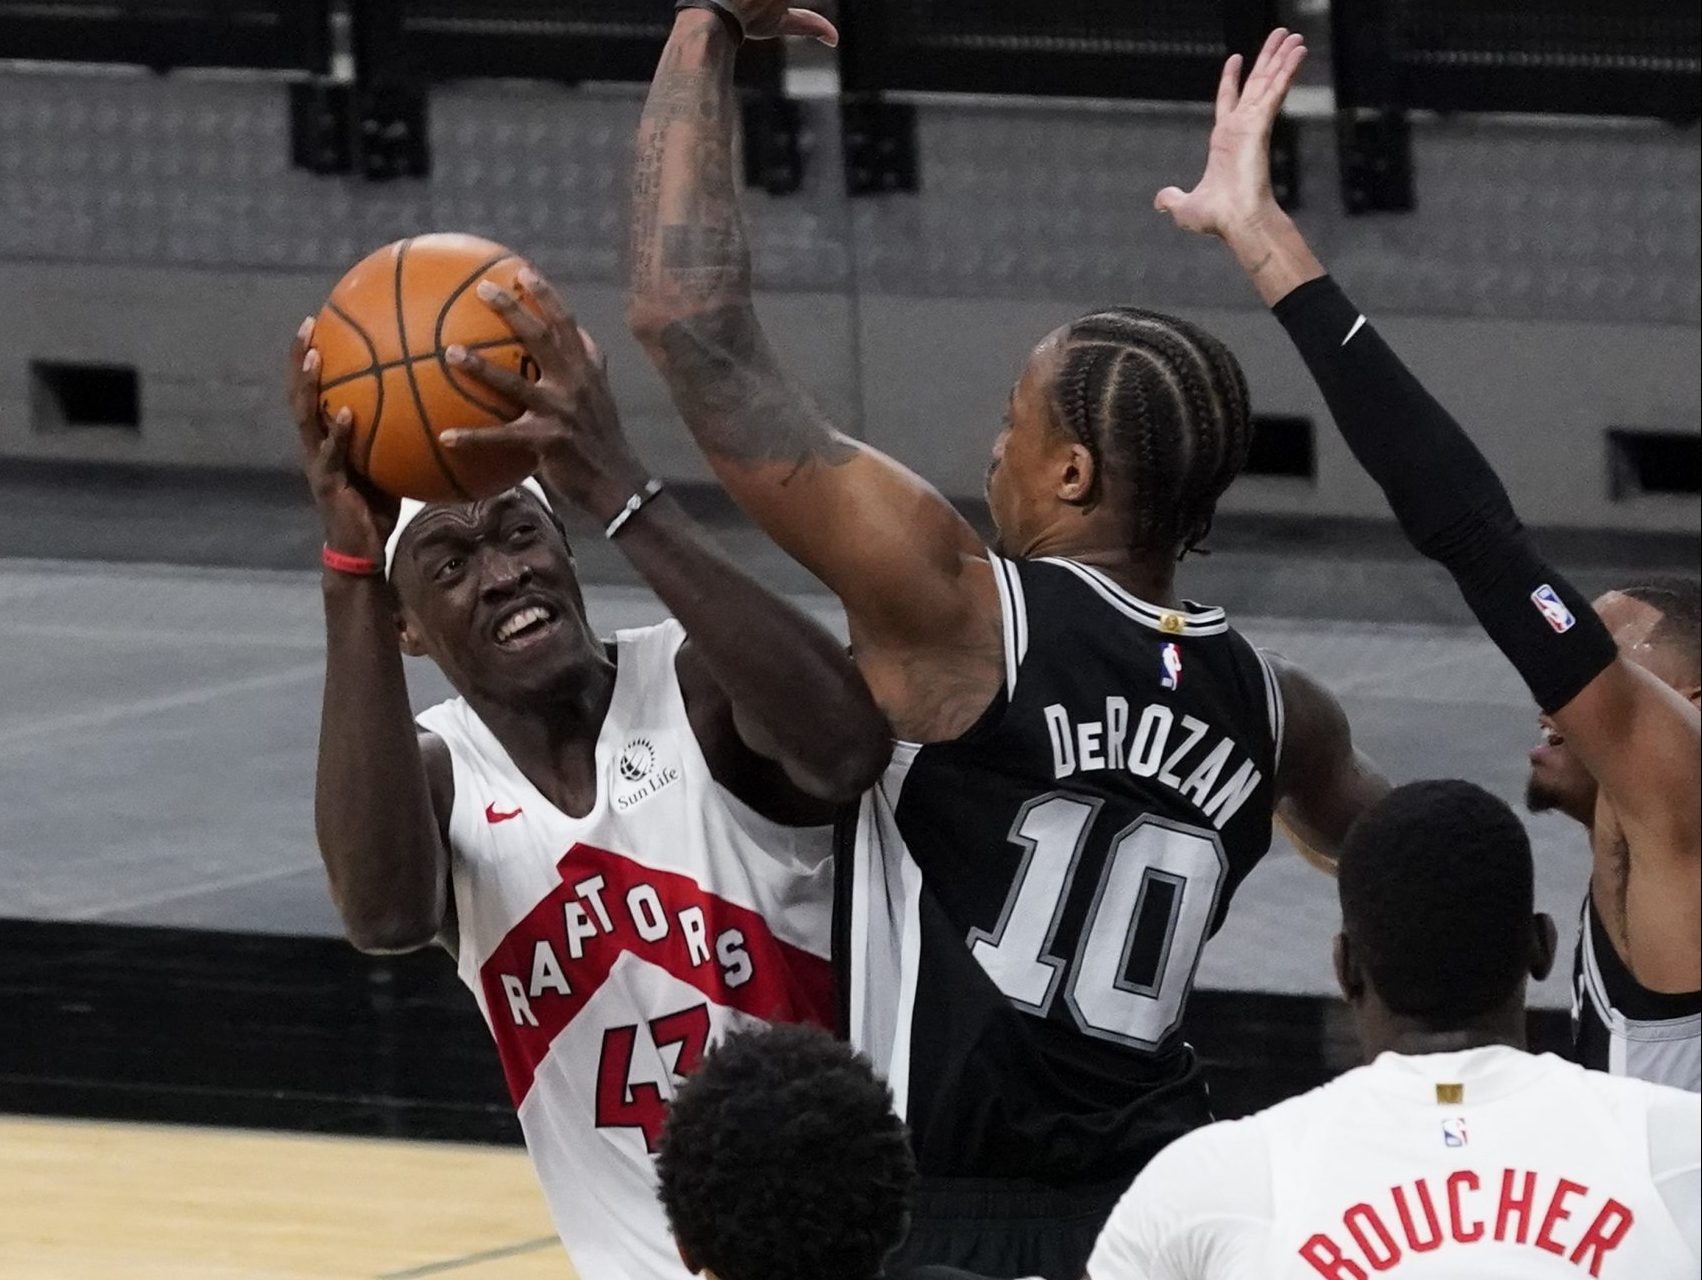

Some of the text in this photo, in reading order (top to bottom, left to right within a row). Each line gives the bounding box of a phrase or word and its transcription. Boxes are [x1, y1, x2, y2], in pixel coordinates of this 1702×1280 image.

[617, 767, 679, 810] Sun Life
[500, 874, 755, 1028] RAPTORS
[965, 790, 1229, 1052] 10
[1297, 1168, 1635, 1280] BOUCHER
